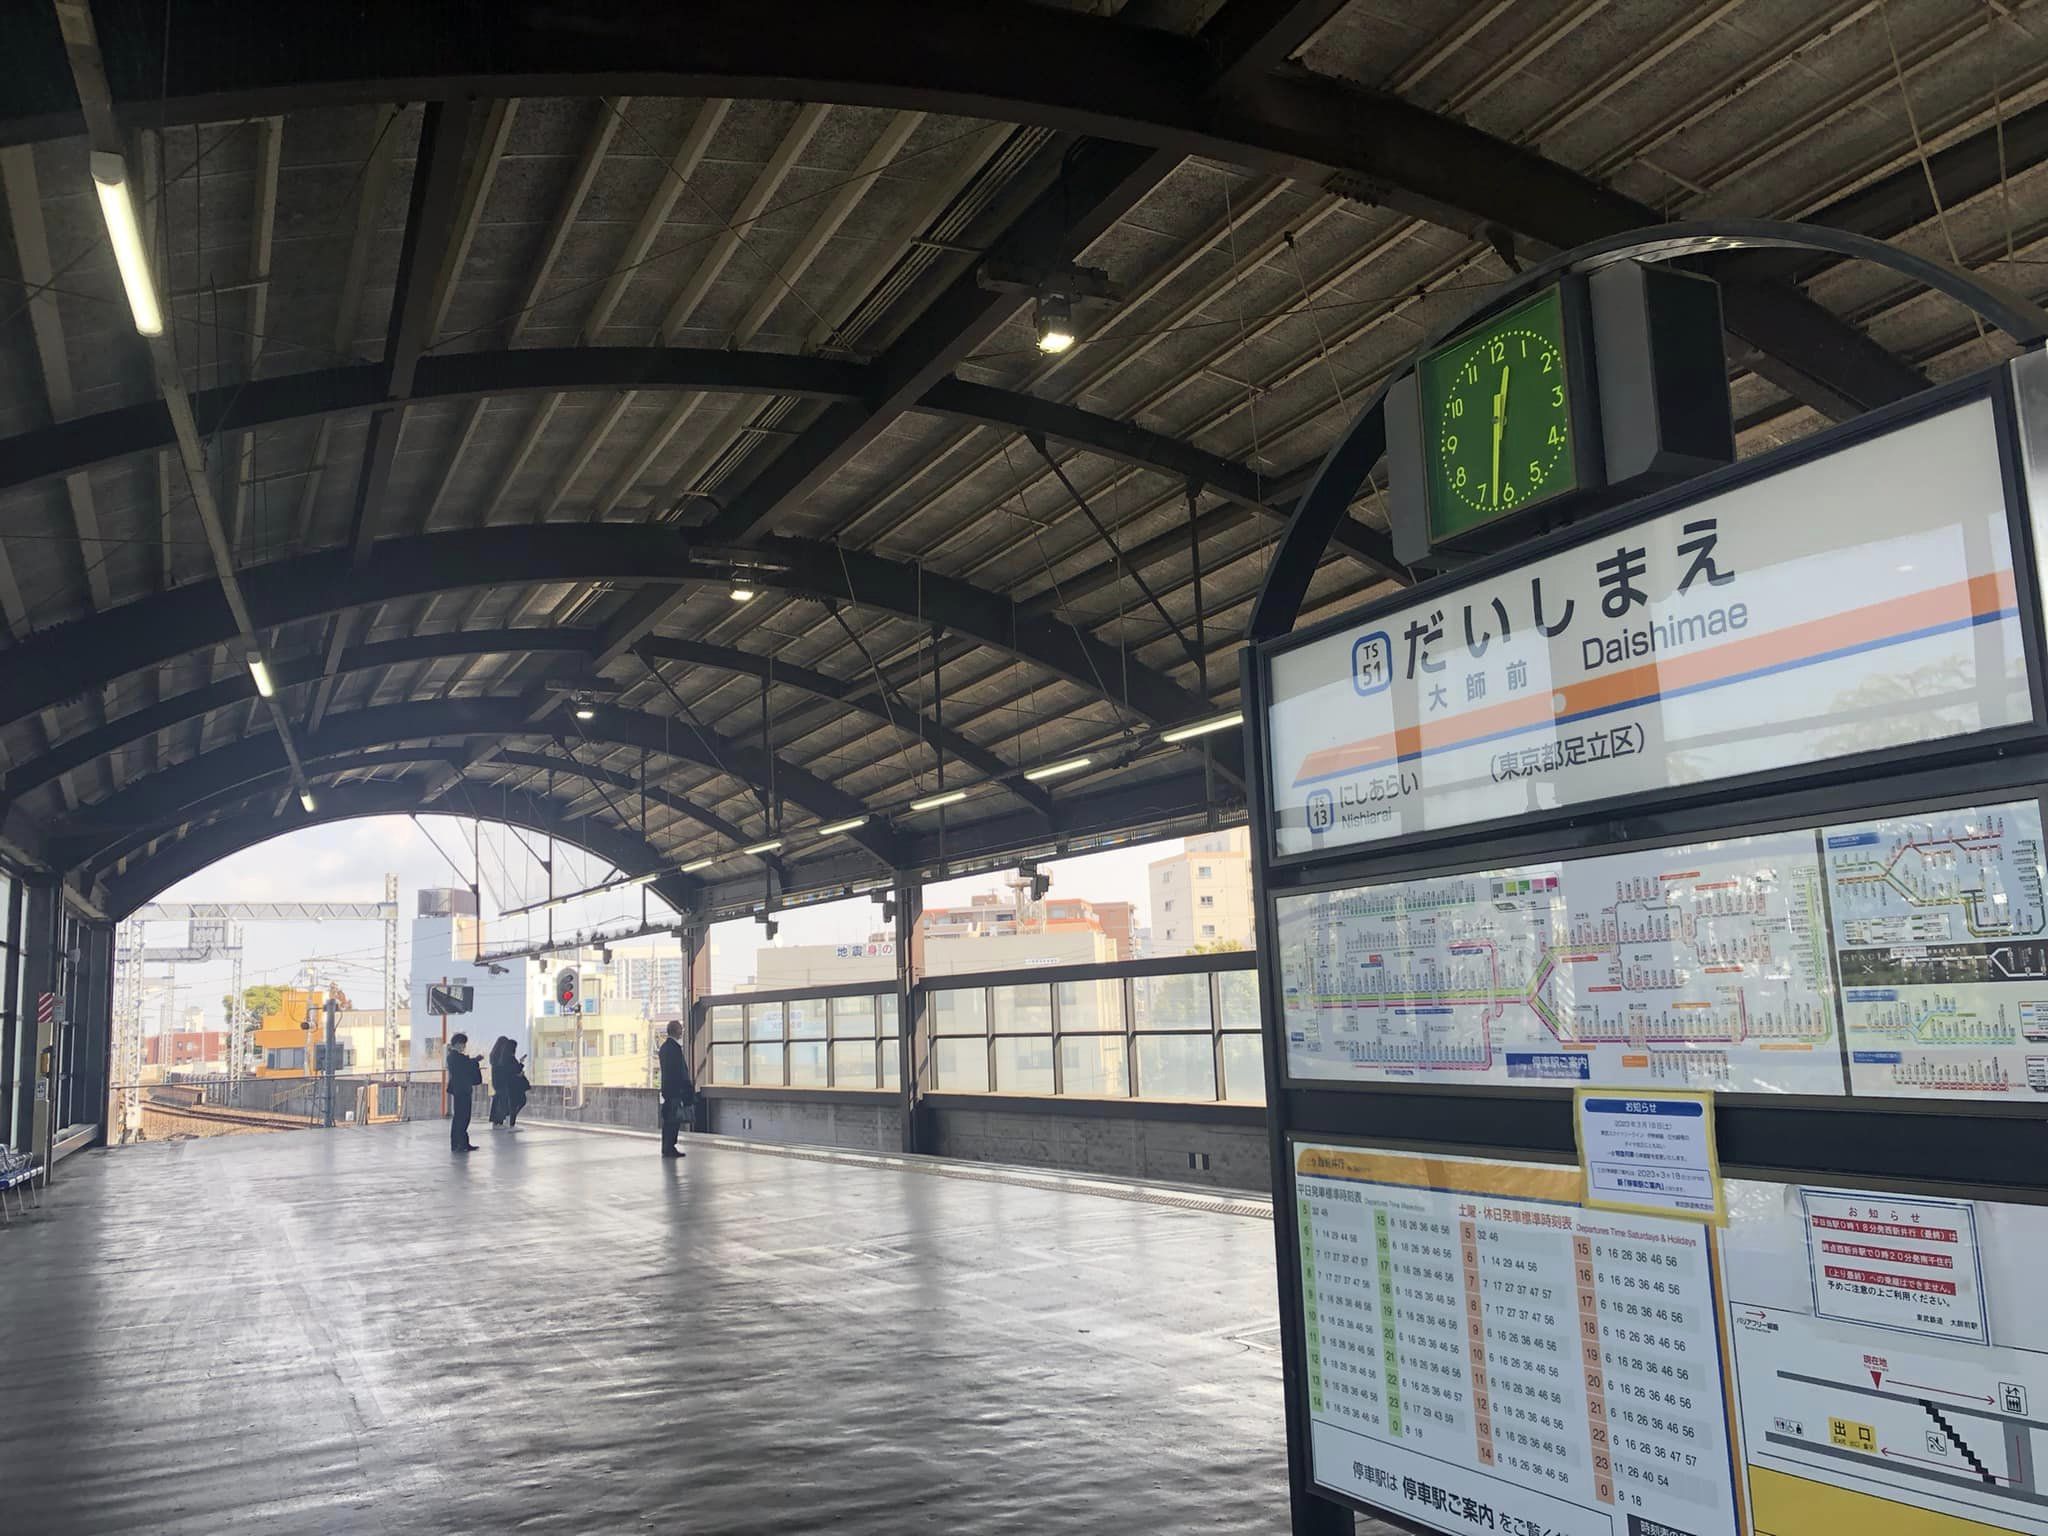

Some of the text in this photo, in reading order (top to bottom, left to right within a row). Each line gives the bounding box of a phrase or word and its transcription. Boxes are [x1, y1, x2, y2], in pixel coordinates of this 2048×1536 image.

[1491, 342, 1504, 364] 12
[1522, 340, 1526, 357] 1
[1540, 352, 1551, 373] 2
[1468, 365, 1477, 384] 11
[1552, 385, 1563, 407] 3
[1452, 399, 1463, 418] 10
[1548, 426, 1559, 444] 4
[1448, 436, 1457, 454] 9
[1456, 467, 1466, 486] 8
[1530, 461, 1540, 482] 5
[1478, 484, 1486, 502] 7
[1503, 483, 1514, 501] 6
[1404, 518, 1734, 679] だいしまえ
[1583, 601, 1748, 670] Daishimae
[1364, 645, 1380, 659] TS
[1363, 665, 1382, 686] 51
[1428, 660, 1527, 711] 大師前
[1340, 773, 1418, 808] にしあらい
[1314, 810, 1327, 826] 13
[1342, 806, 1391, 829] Nishiarai
[1626, 1103, 1657, 1113] お知らせ
[1849, 1206, 1920, 1223] お知らせ
[1377, 1216, 1385, 1226] 15
[1465, 1228, 1471, 1239] 5
[1379, 1238, 1387, 1248] 16
[1577, 1243, 1589, 1255] 15
[1467, 1252, 1472, 1262] 6
[1381, 1261, 1388, 1270] 17
[1469, 1276, 1474, 1286] 7
[1580, 1269, 1591, 1281] 16
[1382, 1283, 1390, 1294] 18
[1471, 1300, 1476, 1311] 8
[1582, 1296, 1592, 1307] 17
[1384, 1306, 1392, 1316] 19
[1384, 1328, 1393, 1340] 20
[1473, 1325, 1479, 1335] 9
[1584, 1322, 1595, 1334] 18
[1386, 1351, 1394, 1362] 21
[1473, 1349, 1482, 1360] 10
[1587, 1348, 1598, 1361] 19
[1387, 1374, 1397, 1385] 22
[1475, 1373, 1483, 1384] 11
[1588, 1374, 1600, 1387] 20
[1389, 1396, 1399, 1408] 23
[1477, 1398, 1487, 1410] 12
[1591, 1402, 1601, 1414] 21
[1393, 1420, 1398, 1431] 0
[1479, 1423, 1488, 1434] 13
[1834, 1421, 1870, 1441] 出口
[1593, 1429, 1605, 1441] 22
[1481, 1448, 1491, 1458] 14
[1595, 1455, 1608, 1469] 23
[1614, 1463, 1668, 1486] 11 26 40 54
[1353, 1461, 1399, 1491] 停車駅は
[1403, 1476, 1494, 1529] 停車駅ご案内
[1601, 1484, 1608, 1496] 0
[1619, 1490, 1641, 1506] 8 18
